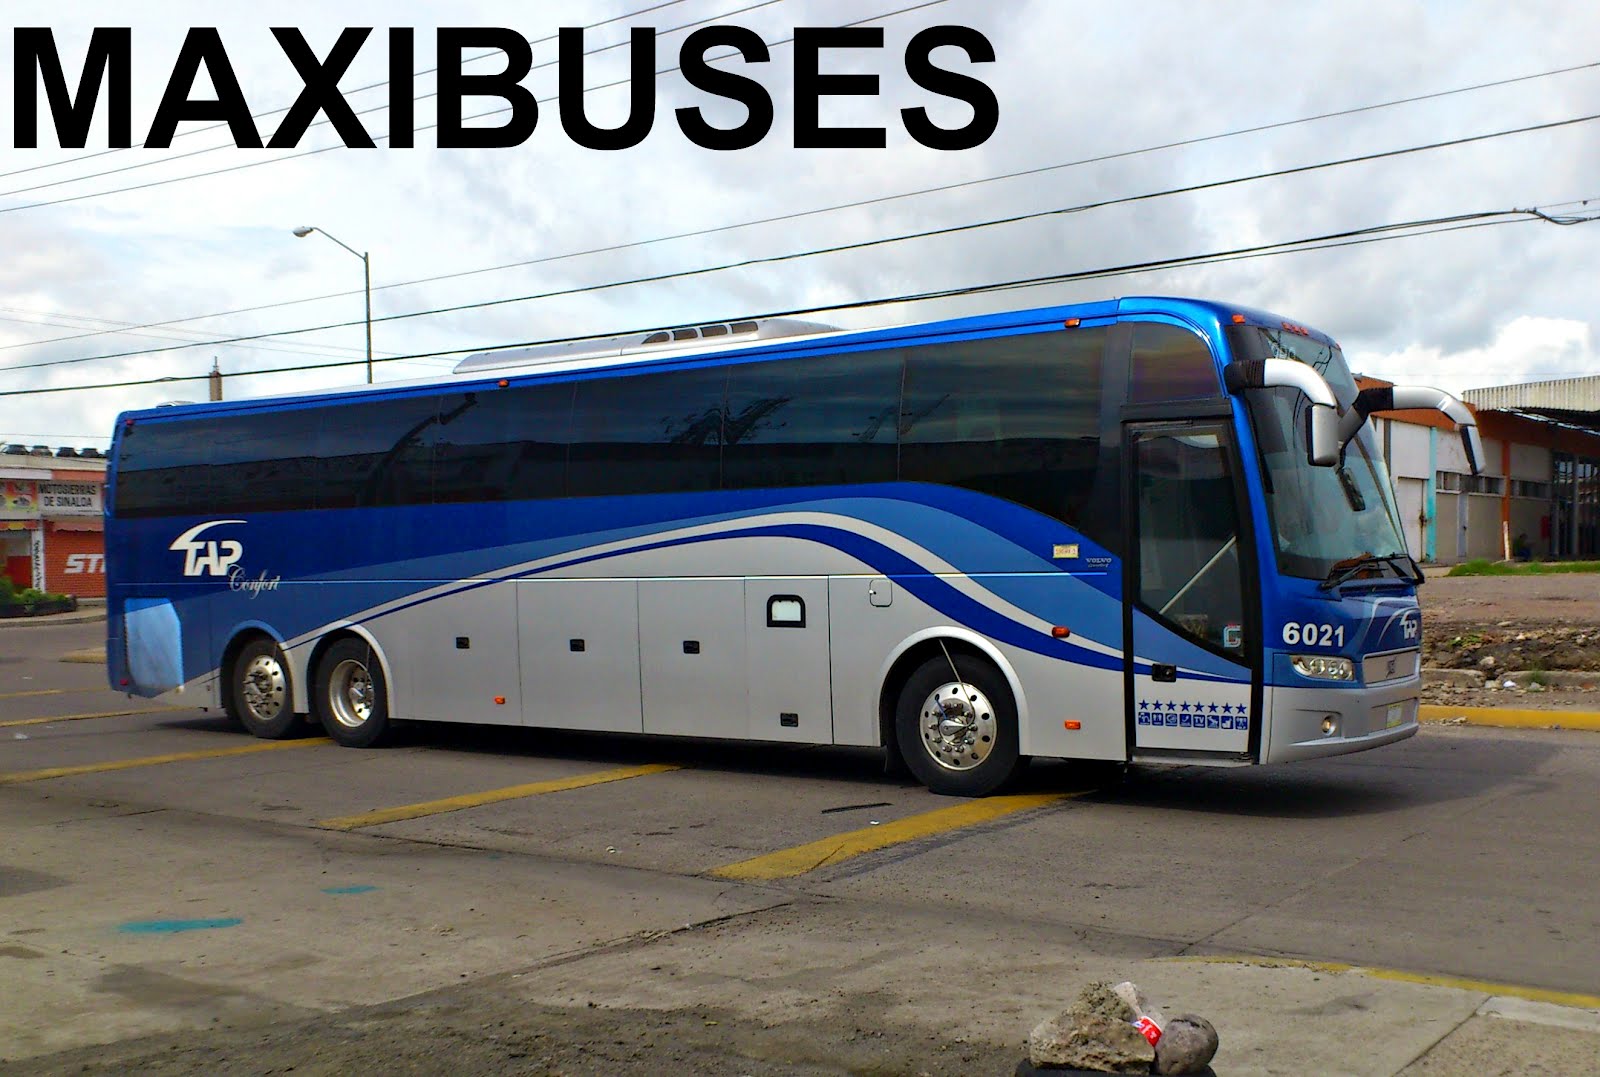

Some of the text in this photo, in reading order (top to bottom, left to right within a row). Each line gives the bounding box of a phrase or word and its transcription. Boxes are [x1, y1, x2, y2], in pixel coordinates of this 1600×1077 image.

[38, 484, 97, 495] MOTOSIERRAS
[44, 496, 93, 508] DE SINALOA
[169, 520, 247, 576] TAP
[1282, 622, 1345, 648] 6021
